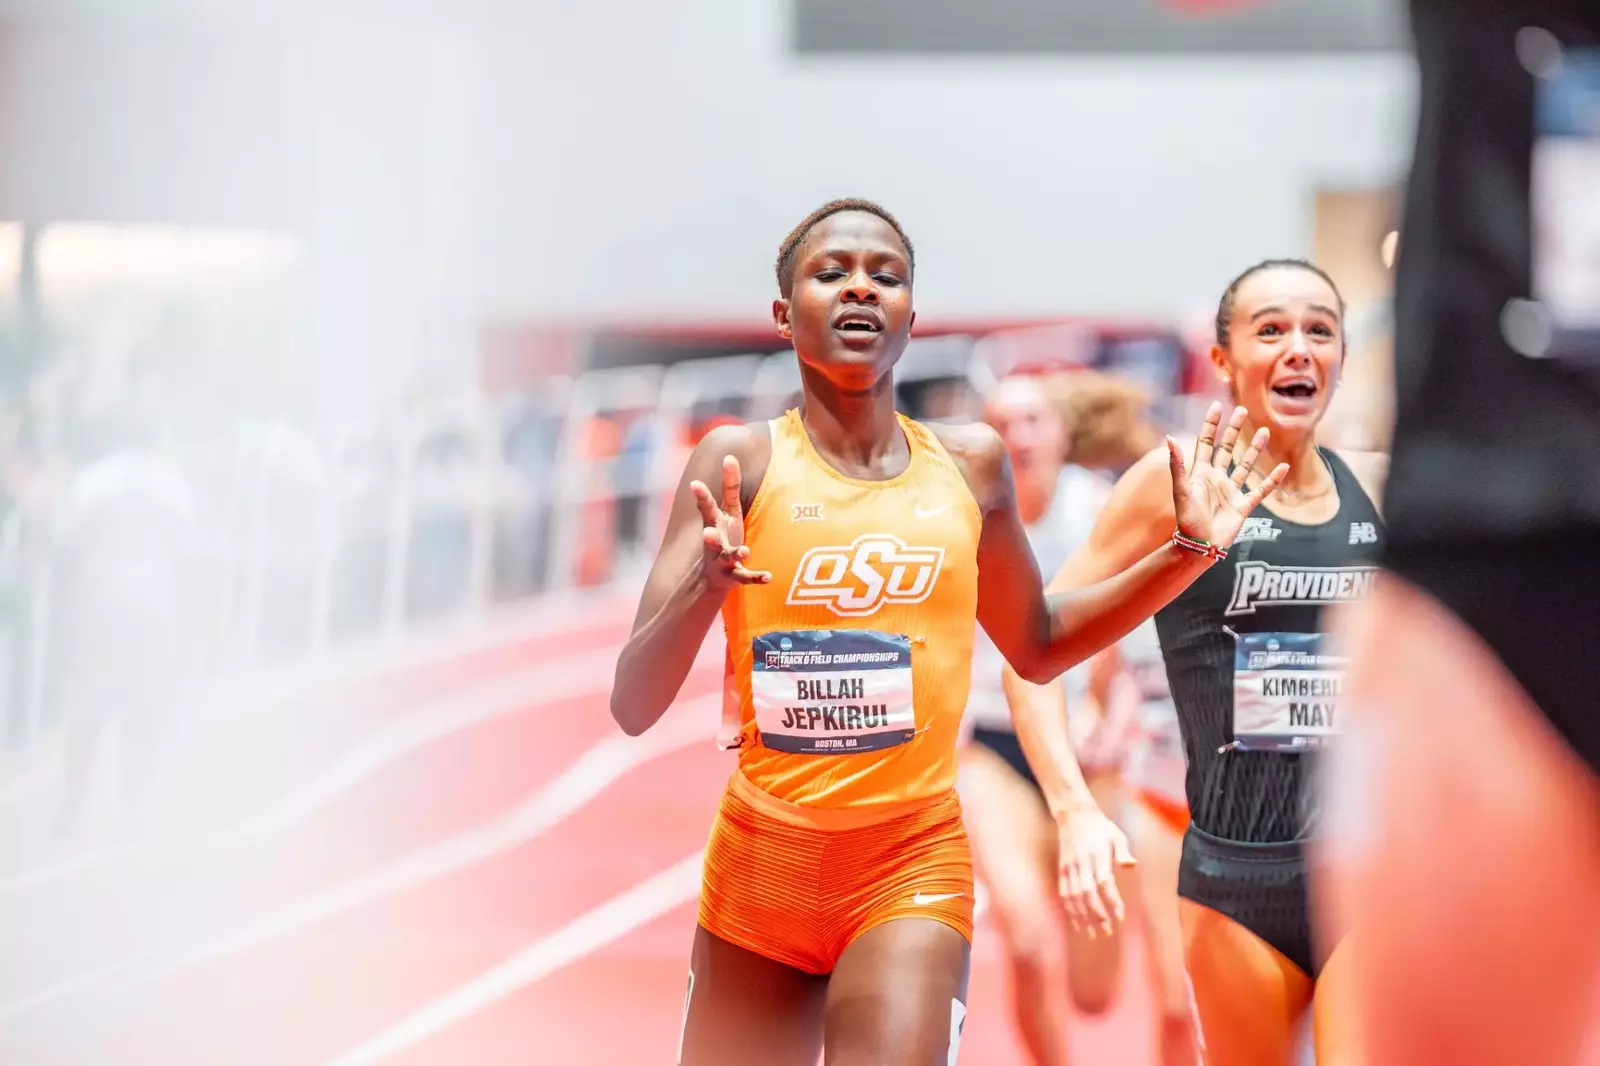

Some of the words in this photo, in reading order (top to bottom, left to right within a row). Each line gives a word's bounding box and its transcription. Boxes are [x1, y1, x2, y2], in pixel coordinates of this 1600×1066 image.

[786, 535, 945, 616] OSU
[1234, 565, 1373, 609] PROVIDEN
[780, 655, 804, 665] TRACK
[811, 654, 832, 665] FIELD
[833, 652, 900, 664] CHAMPIONSHIPS
[797, 678, 864, 700] BILLAH
[1262, 678, 1341, 697] KIMBERL
[781, 704, 889, 731] JEPKIRUI
[1289, 702, 1336, 726] MAY
[815, 739, 845, 749] BOSTON,
[846, 738, 858, 747] MA
